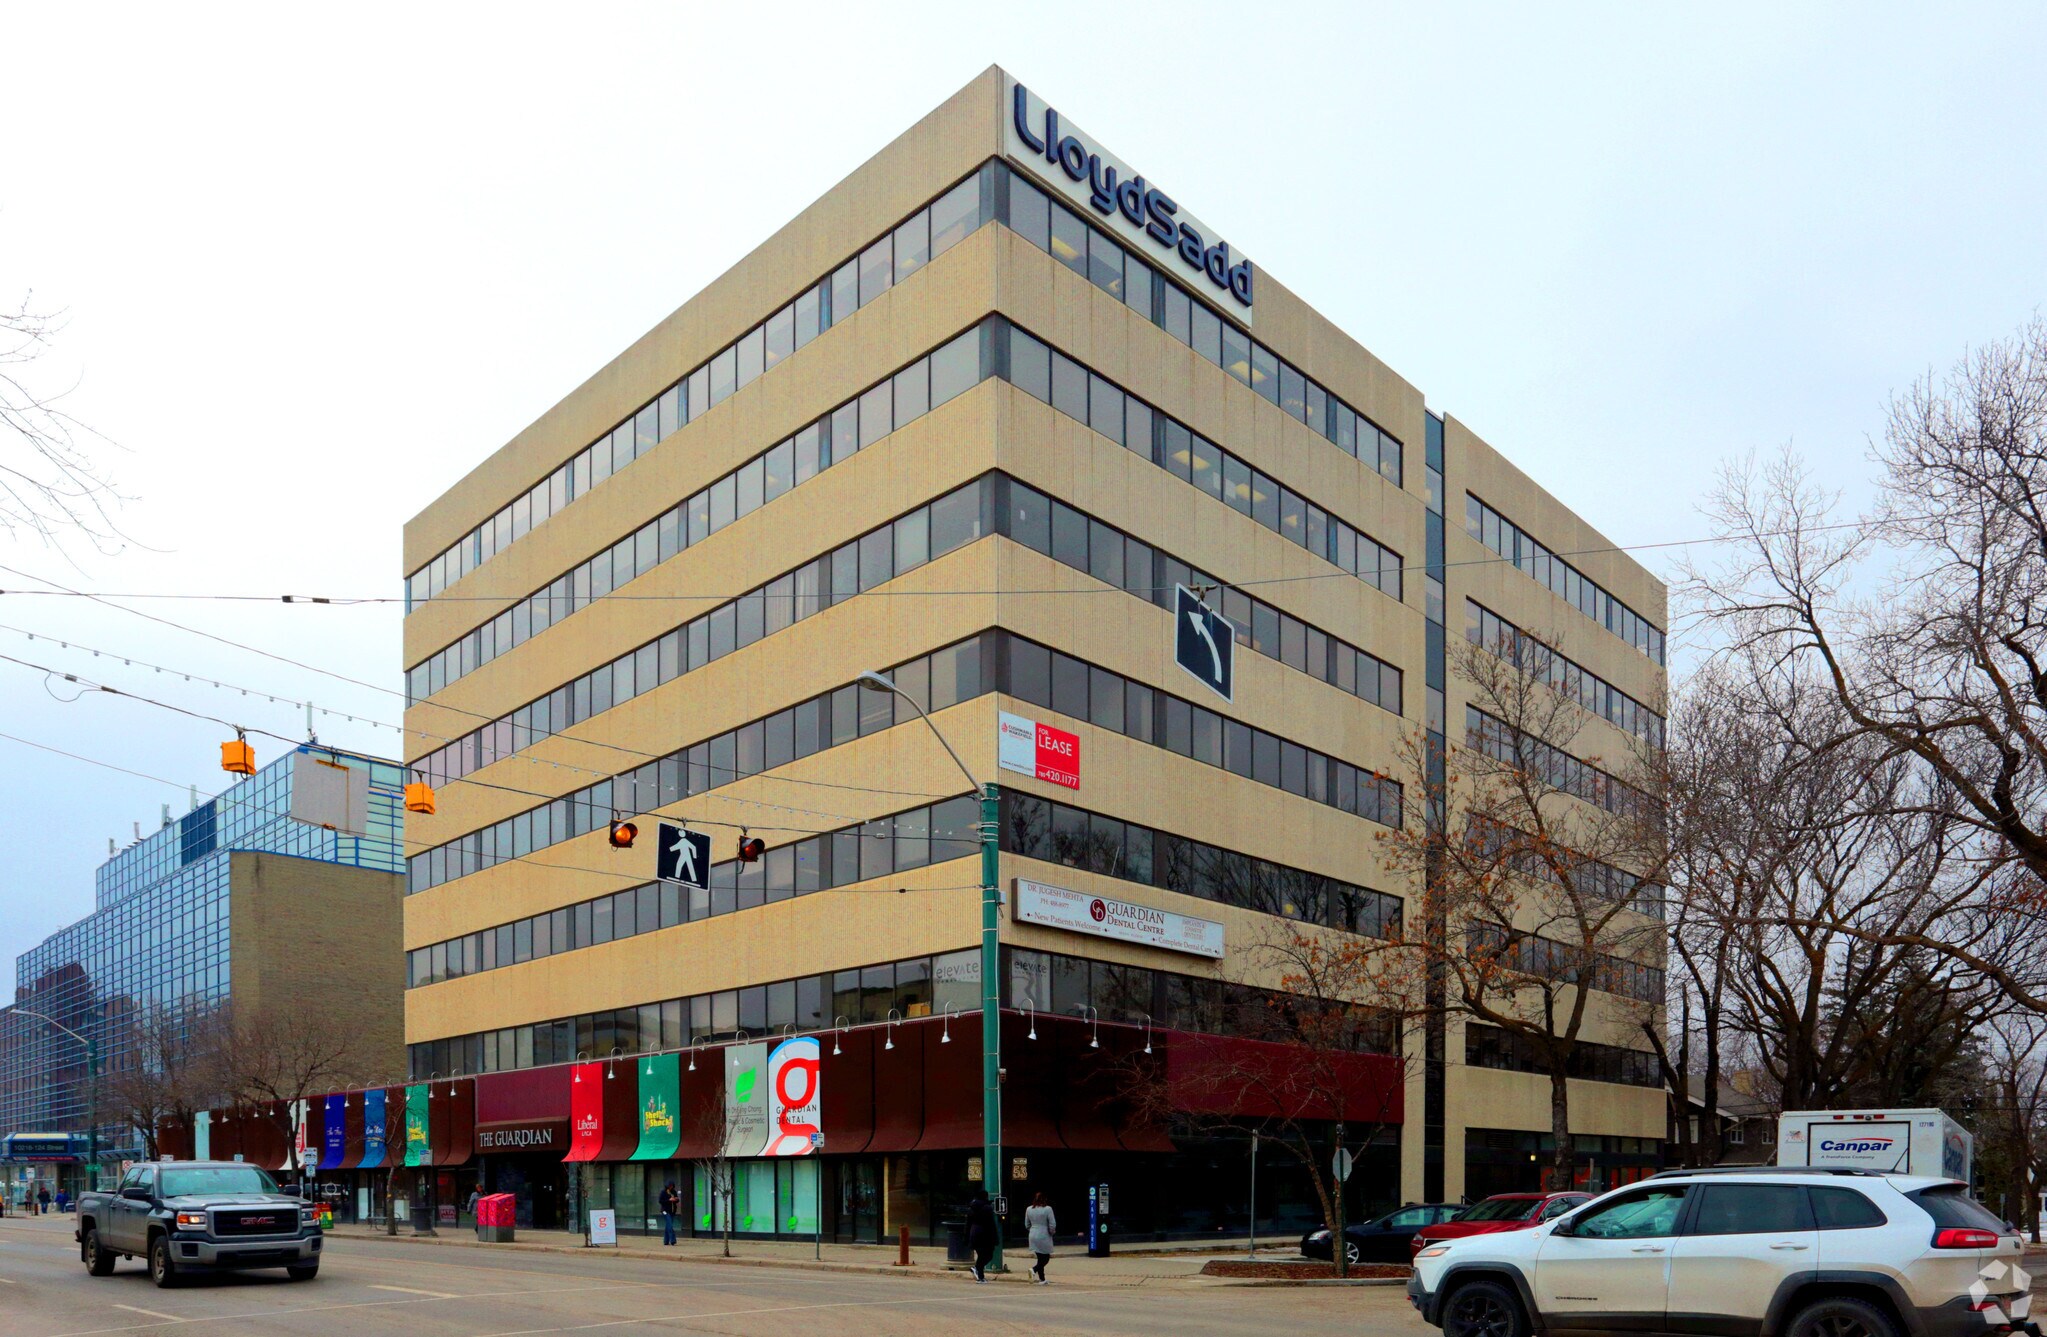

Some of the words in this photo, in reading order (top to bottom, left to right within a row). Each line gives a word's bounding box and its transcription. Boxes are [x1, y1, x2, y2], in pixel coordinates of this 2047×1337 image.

[1013, 83, 1253, 308] LloydSadd
[1038, 735, 1072, 756] LEASE
[1062, 891, 1084, 902] MEHTA
[1107, 902, 1165, 924] GUARDIAN
[1034, 912, 1049, 921] New
[1050, 915, 1074, 926] Patients
[1074, 920, 1101, 932] Welcome
[1158, 937, 1182, 947] Complete
[1183, 941, 1199, 951] Dental
[776, 1104, 817, 1114] GUARDIAN
[577, 1118, 598, 1131] Liberal
[776, 1116, 805, 1125] DENTAL
[480, 1132, 493, 1147] THE
[495, 1129, 552, 1147] GUARDIAN
[1820, 1140, 1893, 1153] Canpar
[1013, 1165, 1028, 1179] 53
[241, 1217, 275, 1225] GMC
